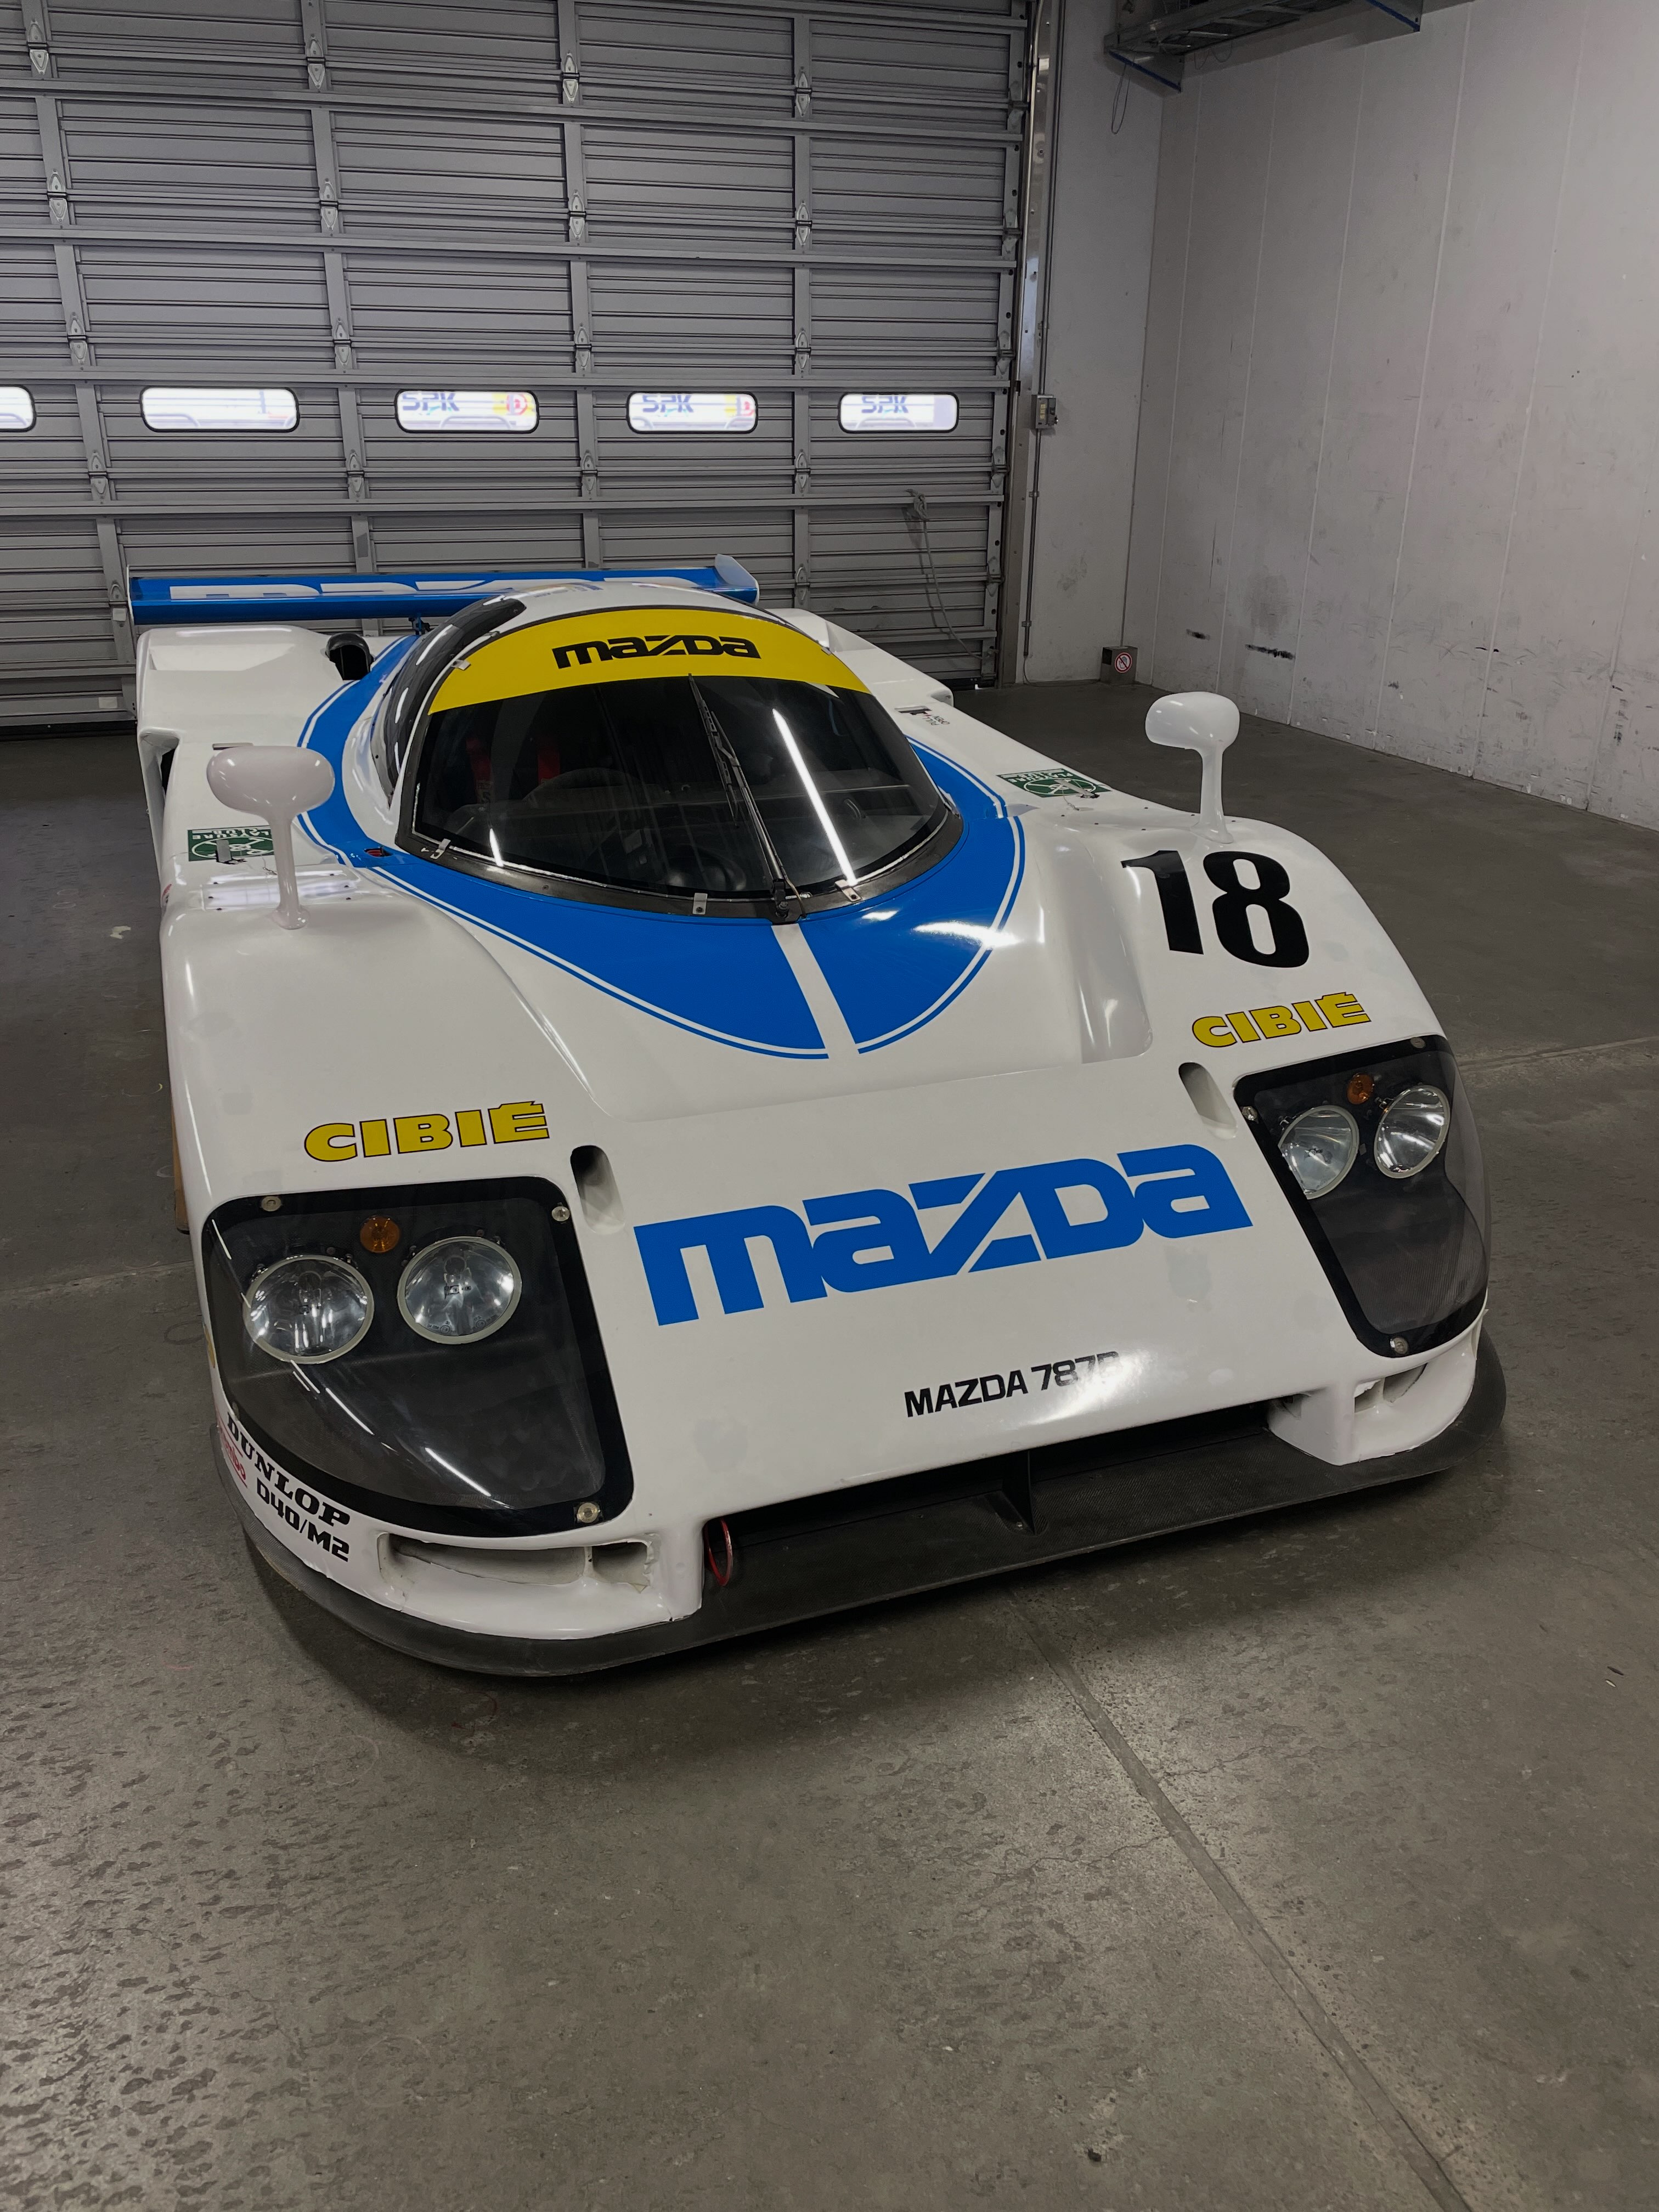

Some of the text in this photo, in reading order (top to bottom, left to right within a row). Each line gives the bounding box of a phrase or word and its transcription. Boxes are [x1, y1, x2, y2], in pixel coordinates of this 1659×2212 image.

[402, 392, 460, 411] SPK
[1121, 850, 1310, 968] 18
[1192, 992, 1372, 1048] CIBIÉ
[304, 1101, 550, 1163] CIBIÉ
[904, 1369, 1029, 1418] MAZDA
[228, 1412, 350, 1527] DUNLOP
[257, 1477, 349, 1562] D40/M2
